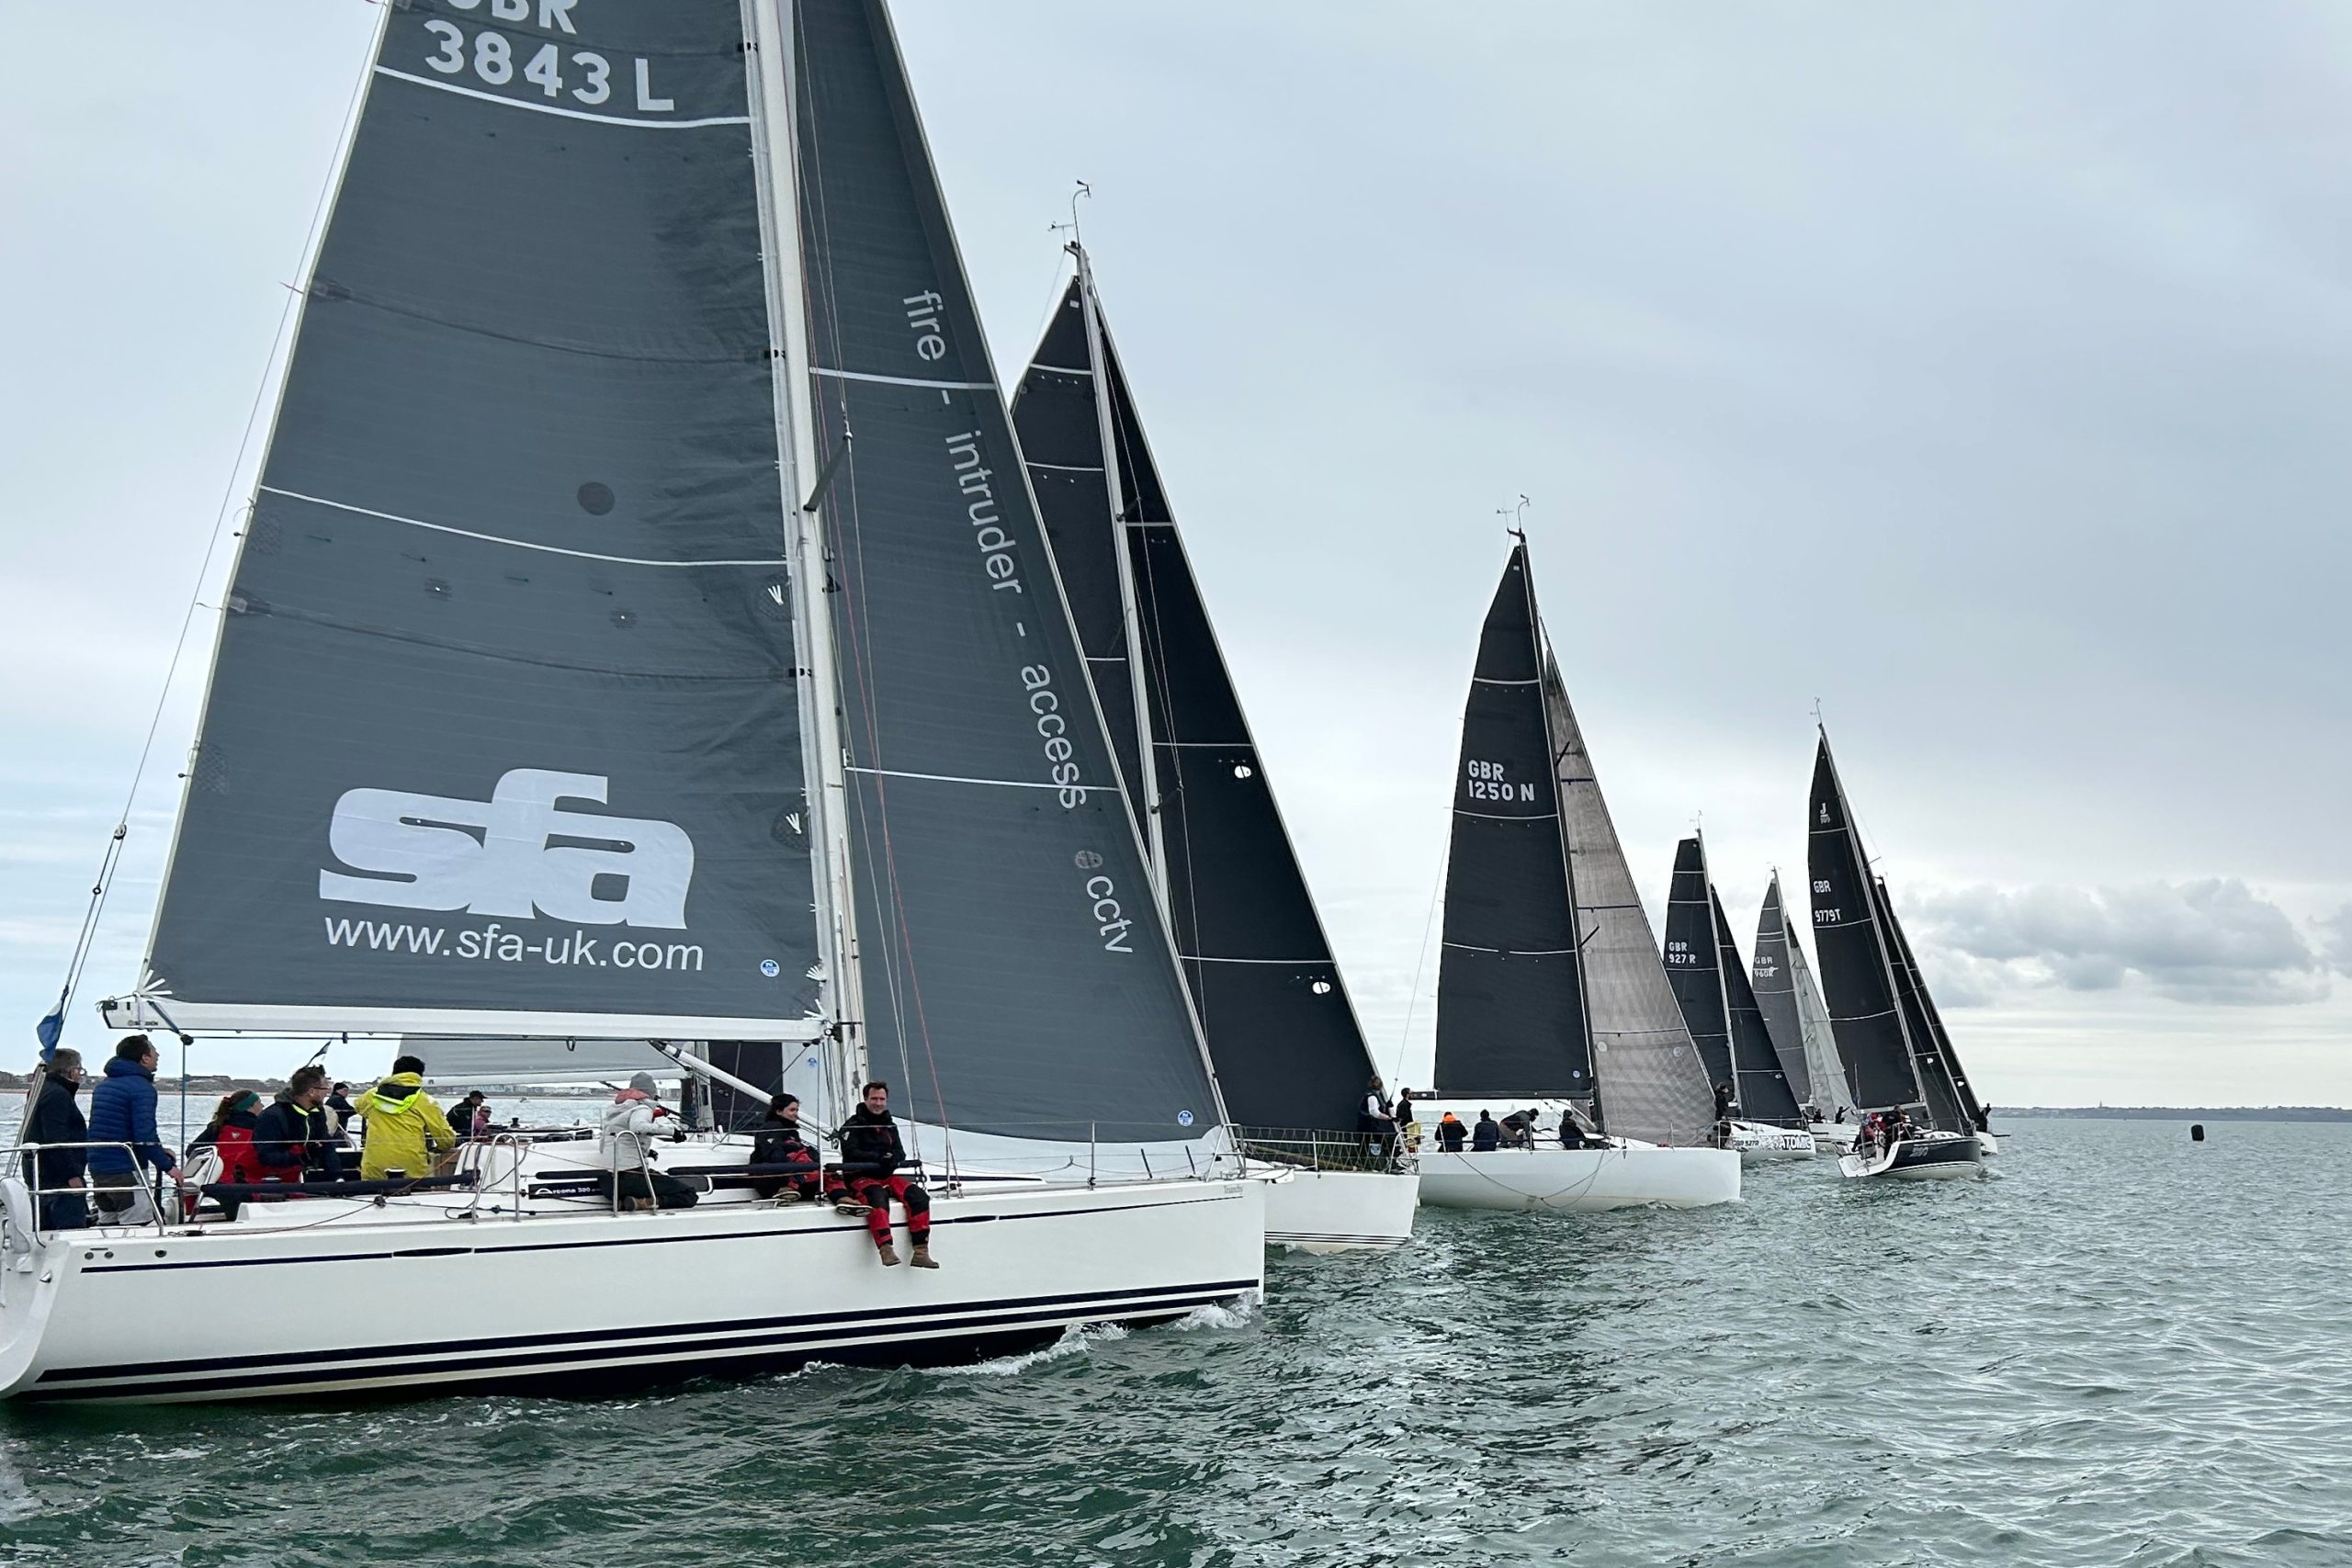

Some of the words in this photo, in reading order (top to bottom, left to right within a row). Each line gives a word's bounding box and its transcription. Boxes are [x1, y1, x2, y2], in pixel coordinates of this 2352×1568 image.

[424, 19, 611, 106] 3843
[635, 58, 675, 112] L
[903, 289, 946, 361] fire
[945, 430, 1023, 595] intruder
[1021, 663, 1087, 810] access
[1086, 875, 1134, 954] cctv
[1468, 759, 1504, 782] GBR
[1468, 779, 1515, 801] 1250
[1520, 783, 1536, 802] N
[319, 768, 695, 930] sfa
[1813, 880, 1832, 894] GBR
[324, 916, 705, 972] www.sfa-uk.com
[1668, 941, 1688, 952] GBR
[1668, 953, 1688, 964] 927
[1689, 953, 1697, 964] R
[1754, 956, 1773, 964] GBR
[1779, 1134, 1812, 1150] ATOMIC
